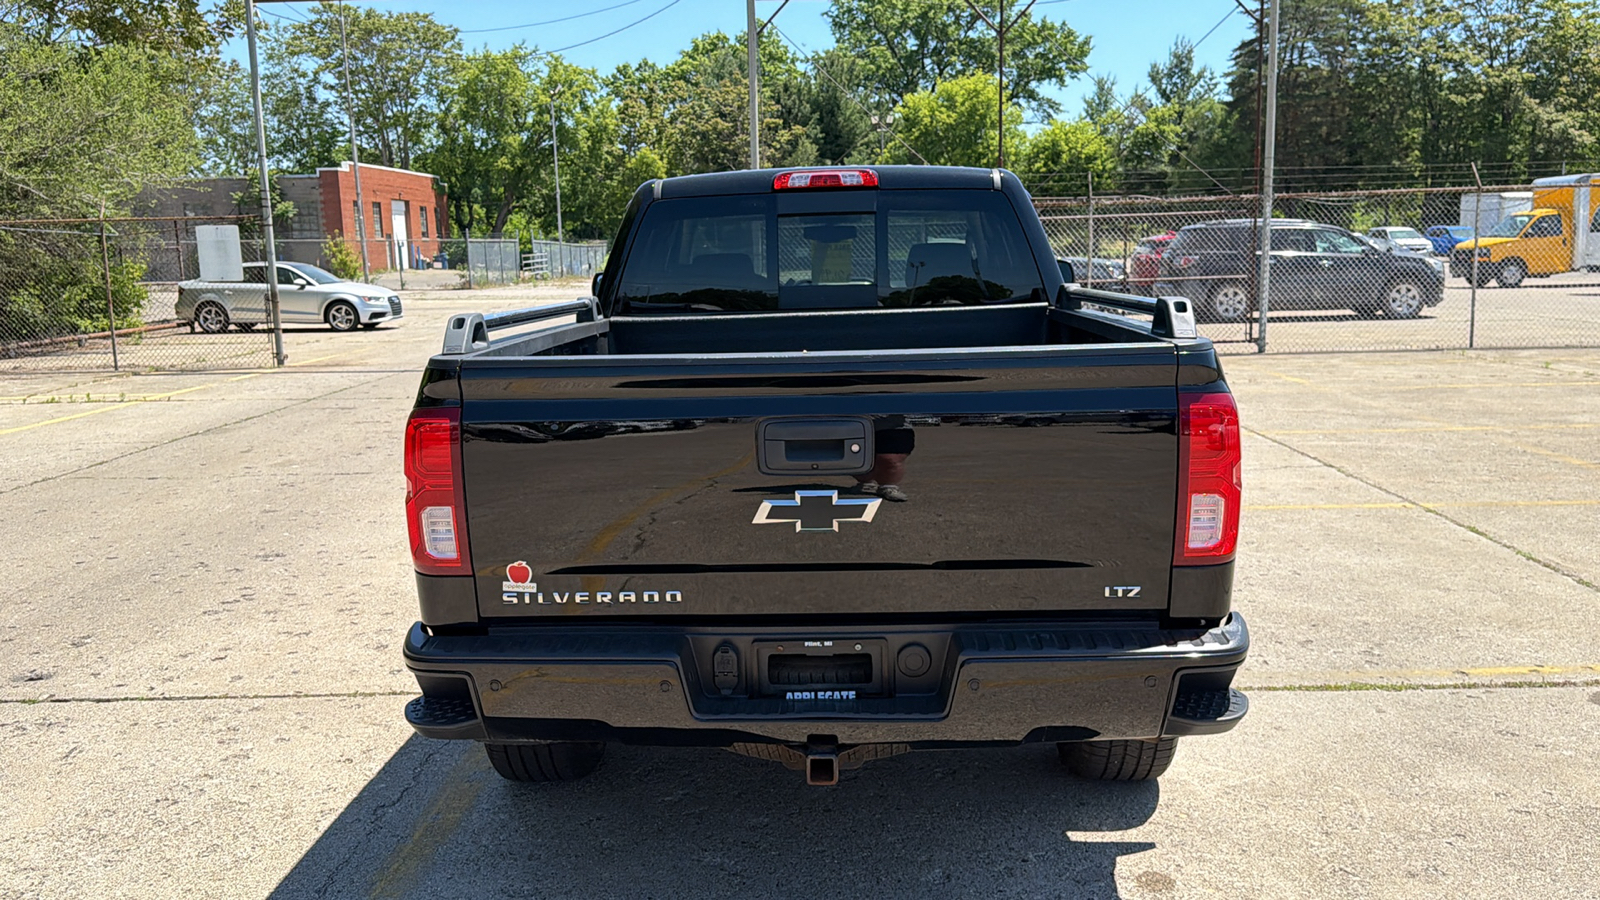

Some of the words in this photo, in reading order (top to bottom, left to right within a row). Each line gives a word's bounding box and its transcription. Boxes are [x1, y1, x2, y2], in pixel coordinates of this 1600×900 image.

[502, 590, 683, 605] SILVERADO
[1104, 586, 1142, 598] LTZ
[785, 691, 857, 700] APPLEGATE
